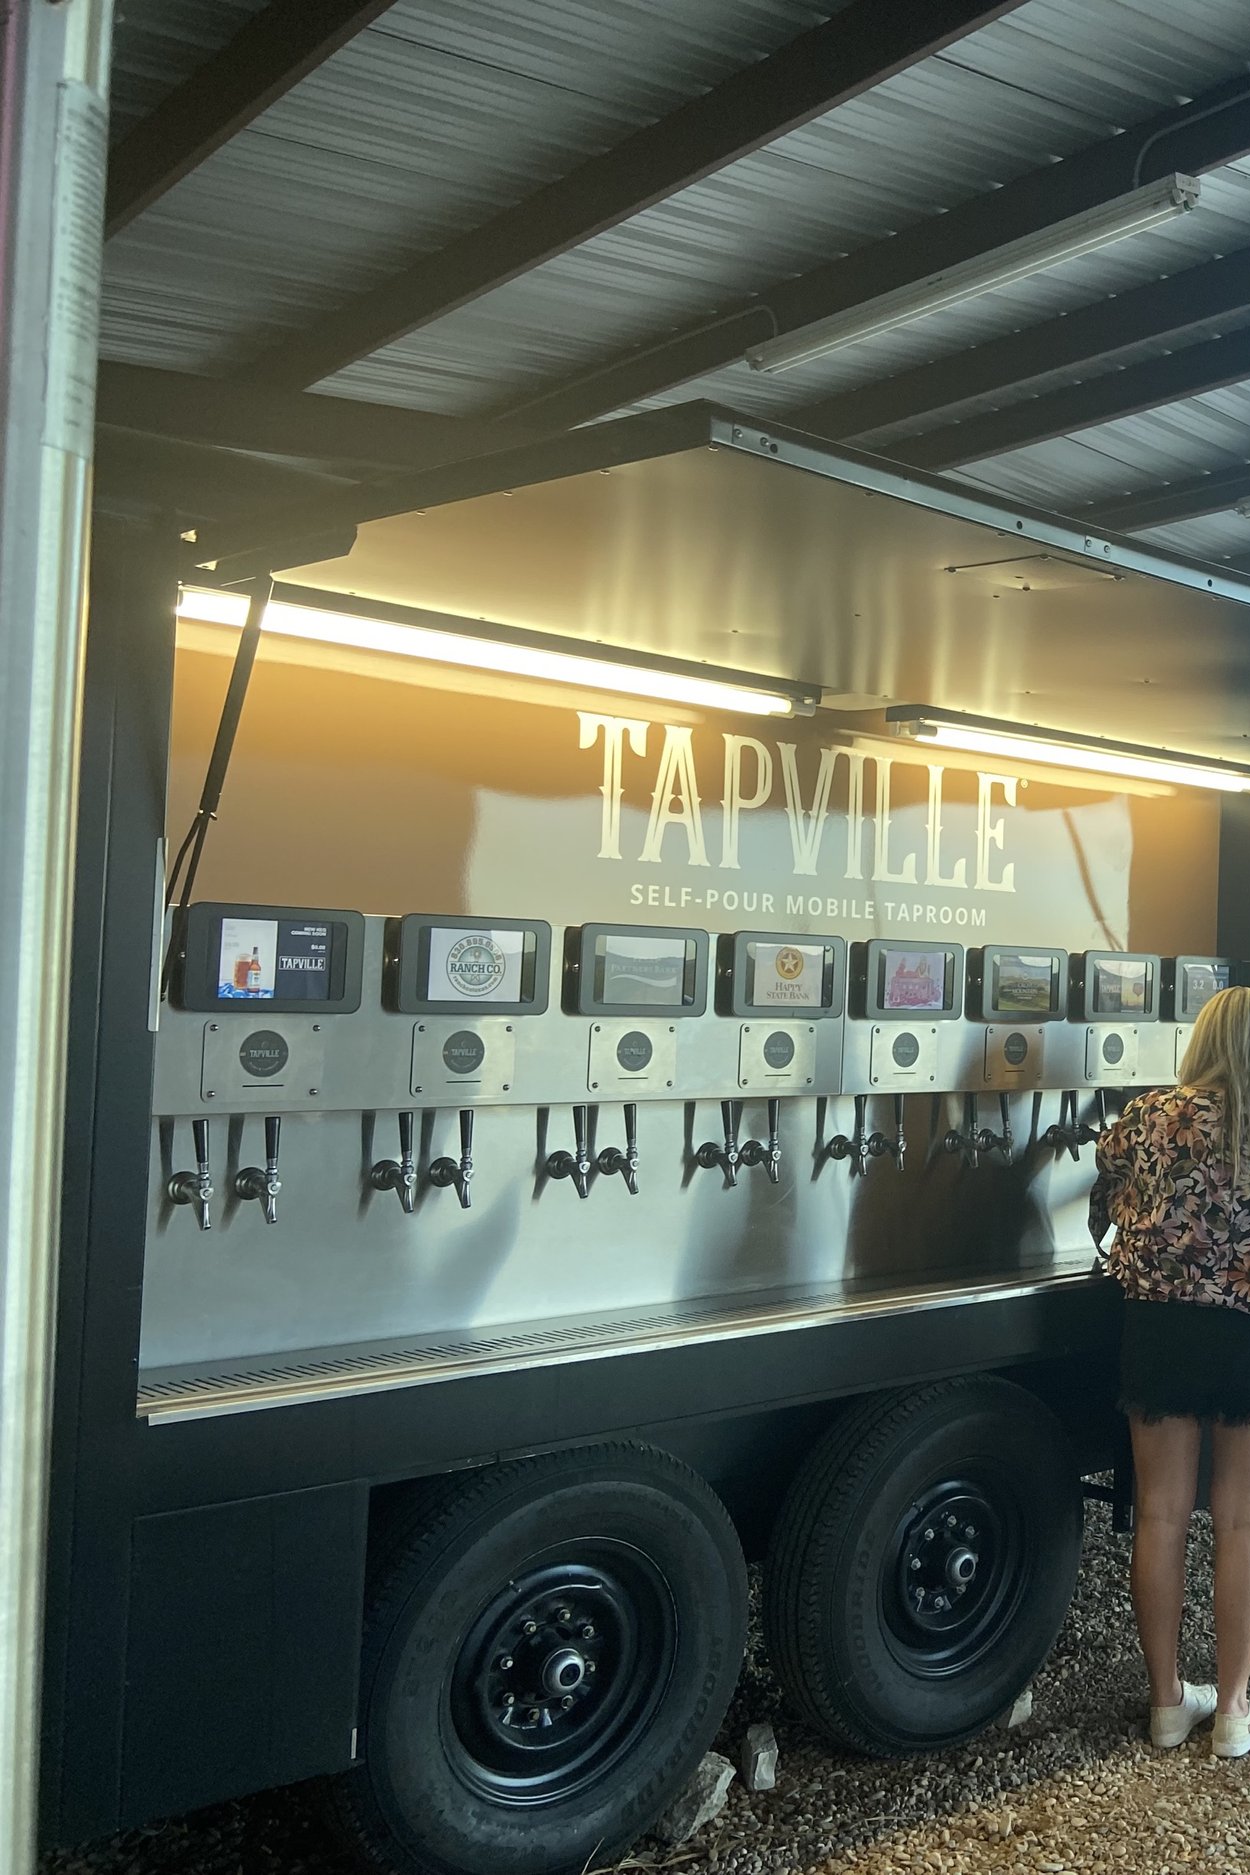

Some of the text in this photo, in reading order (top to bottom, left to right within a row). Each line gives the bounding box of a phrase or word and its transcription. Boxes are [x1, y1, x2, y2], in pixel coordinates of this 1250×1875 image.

[576, 711, 1019, 893] TAPVILLE
[630, 884, 987, 926] SELF-POUR MOBILE TAPROOM
[281, 957, 323, 969] TAPVILLE
[450, 963, 502, 974] RANCH CO.
[250, 1049, 279, 1058] TAPVILLE
